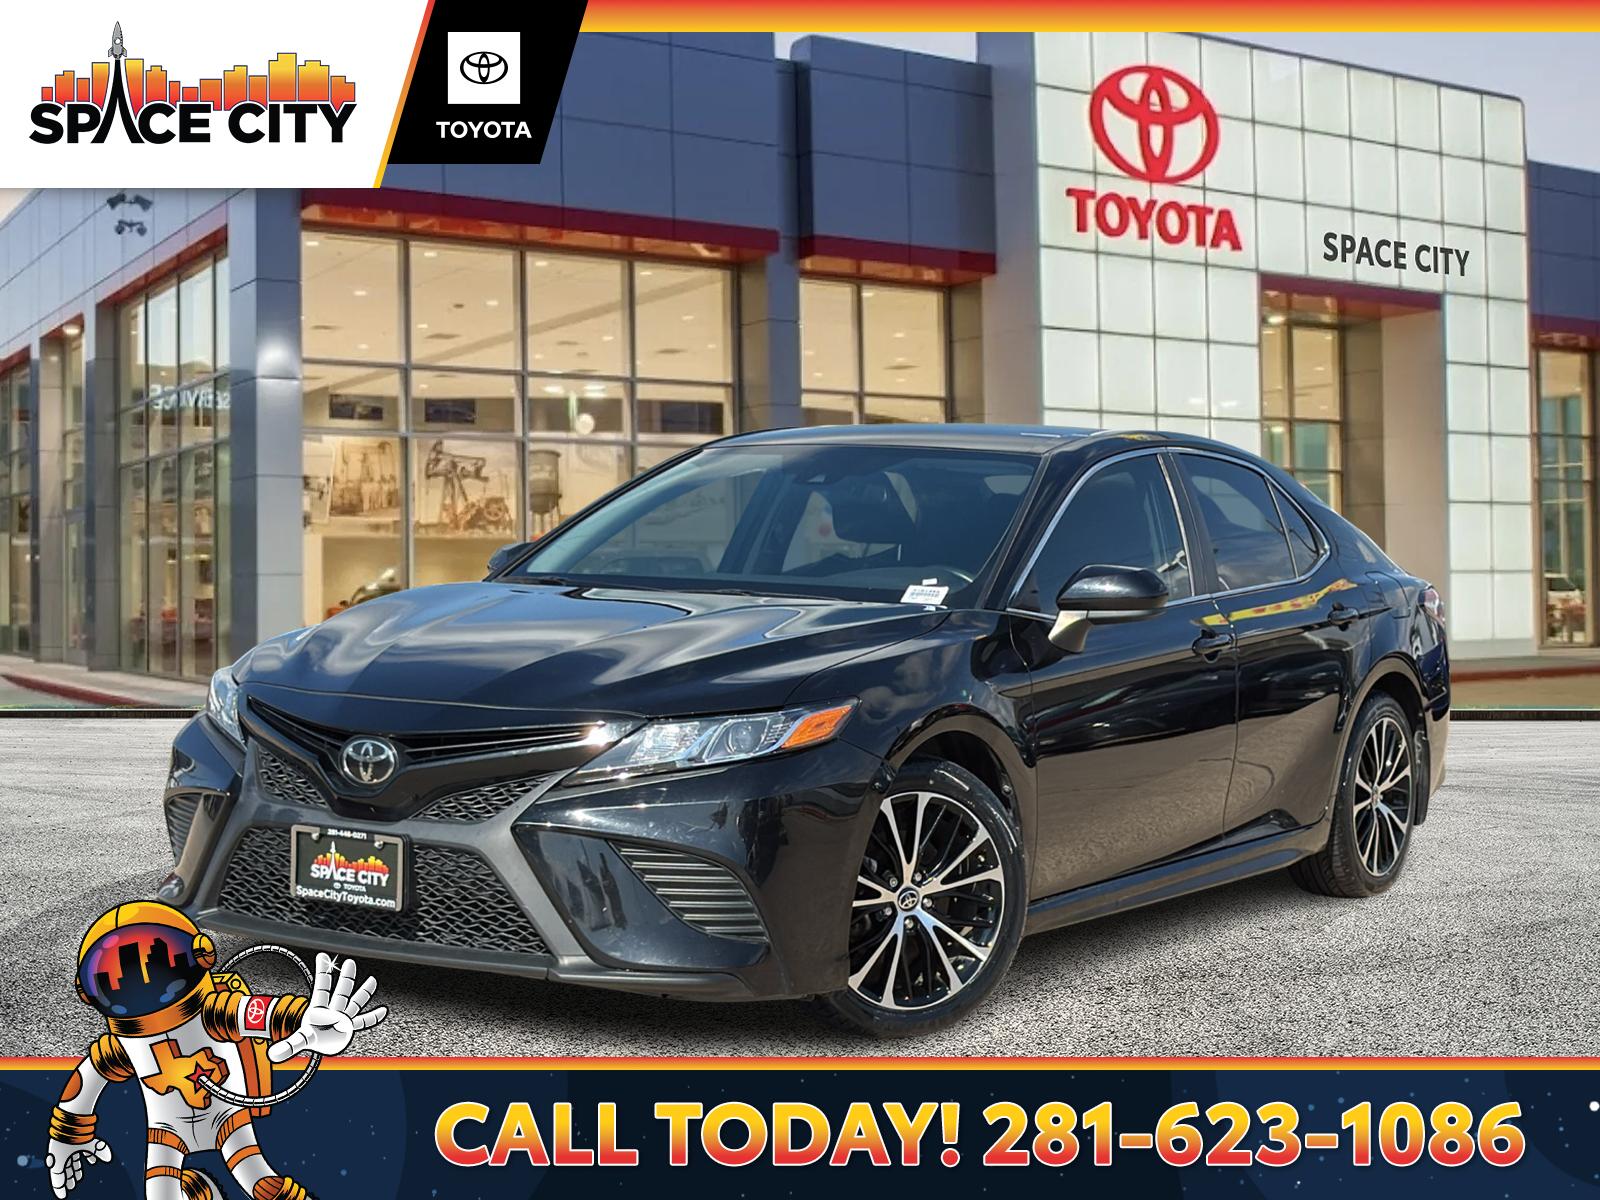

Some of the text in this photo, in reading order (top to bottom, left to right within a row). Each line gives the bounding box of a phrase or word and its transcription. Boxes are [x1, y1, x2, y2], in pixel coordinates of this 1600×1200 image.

[1066, 187, 1243, 251] TOYOTA
[1323, 232, 1470, 277] SPACE CITY
[310, 852, 390, 887] SPACE CITY
[296, 885, 396, 908] SpaceCityToyota.com
[342, 883, 367, 892] TOYOTA
